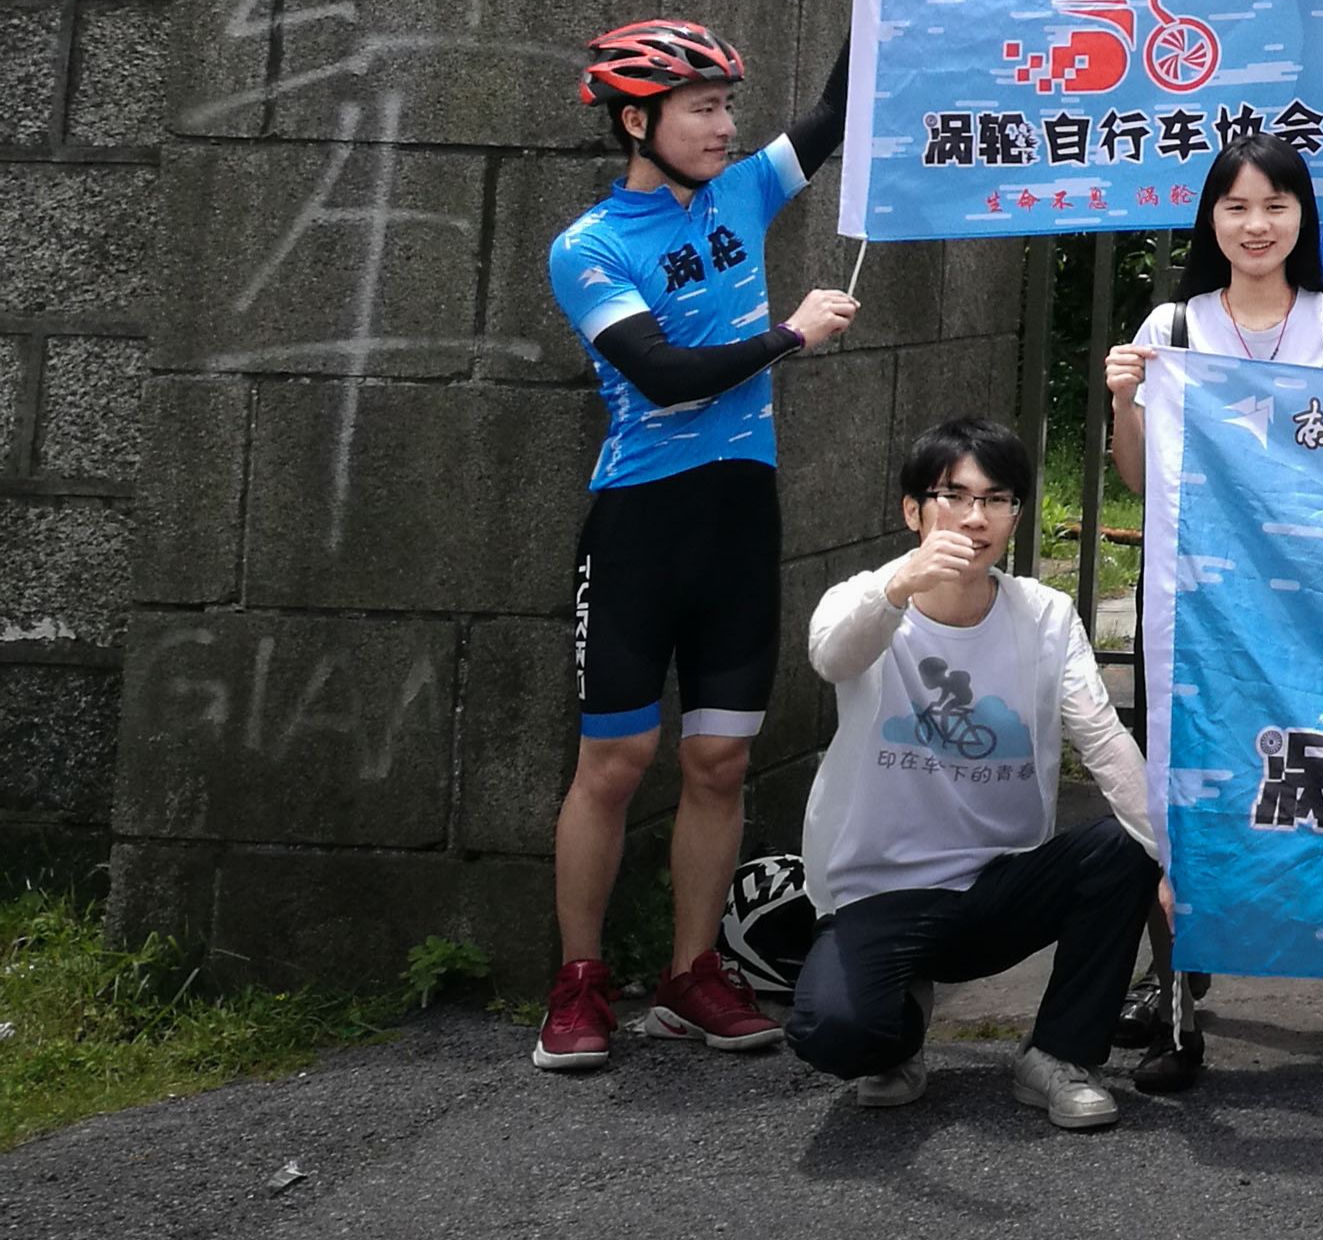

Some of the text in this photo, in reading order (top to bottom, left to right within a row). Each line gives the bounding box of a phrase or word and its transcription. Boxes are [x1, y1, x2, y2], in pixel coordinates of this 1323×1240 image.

[985, 183, 1199, 213] 生命不息 涡轮
[660, 224, 747, 294] 涡轮
